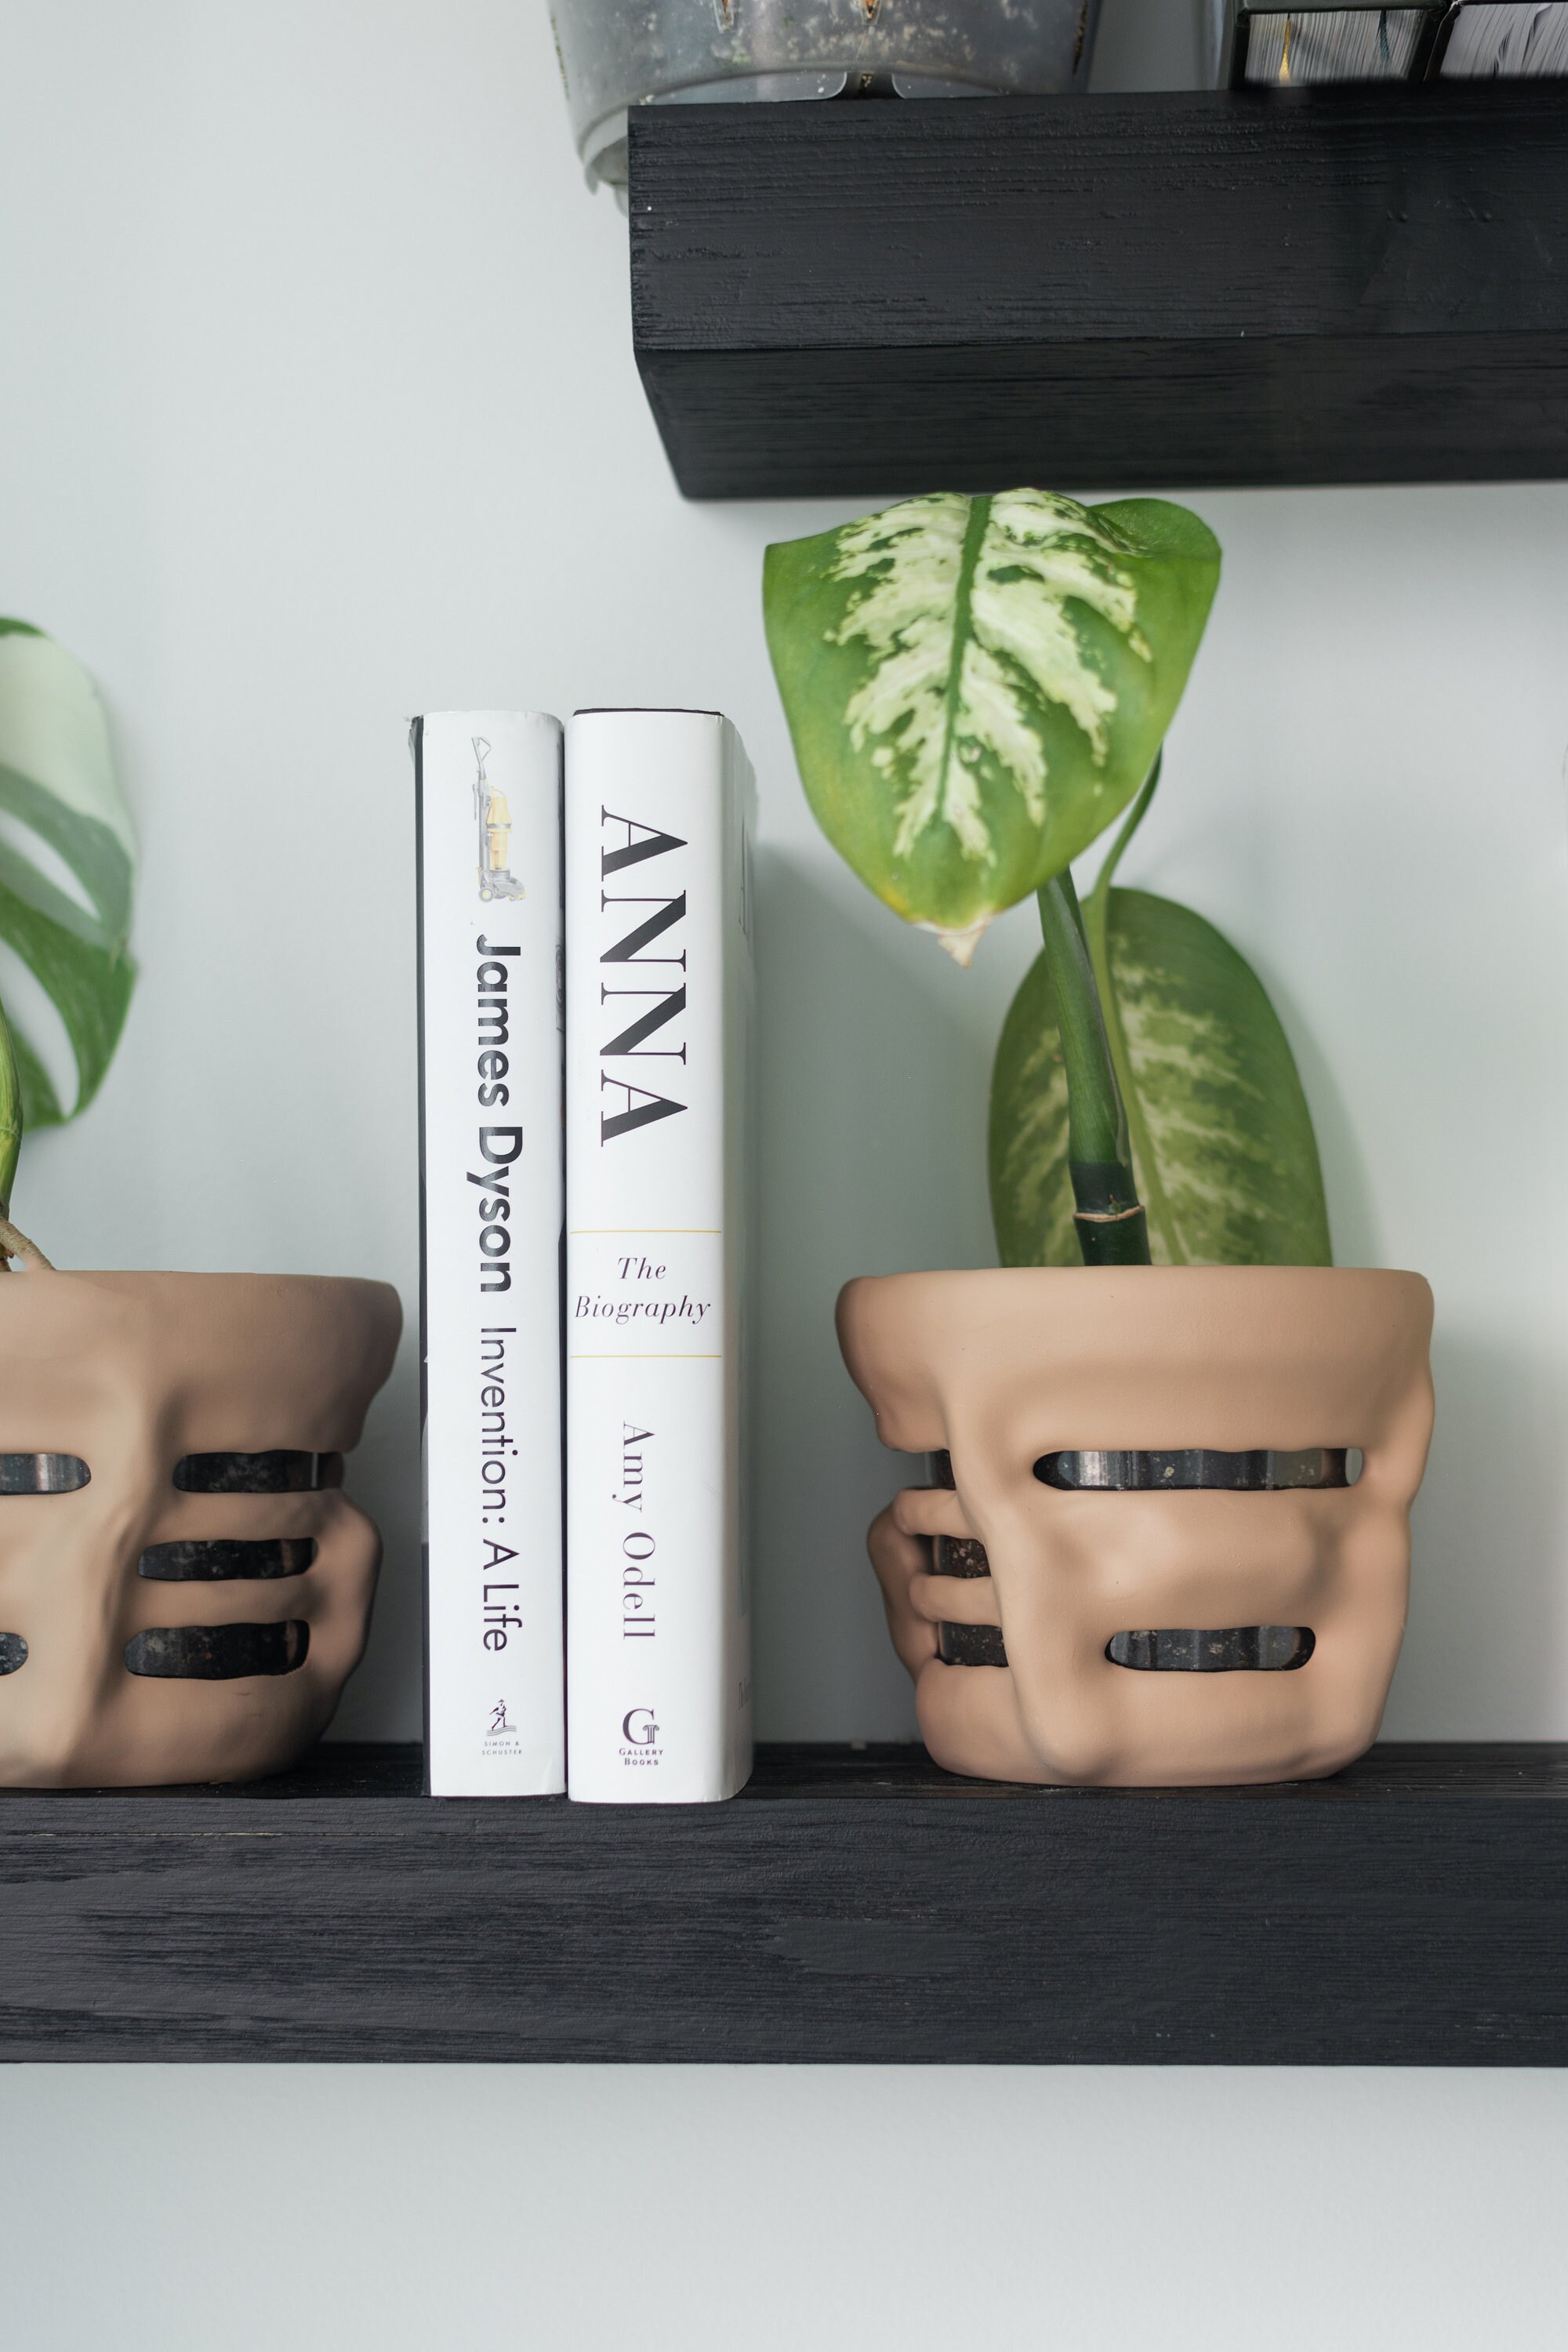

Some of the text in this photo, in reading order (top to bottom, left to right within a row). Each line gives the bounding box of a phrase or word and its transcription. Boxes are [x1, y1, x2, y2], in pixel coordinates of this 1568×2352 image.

[600, 804, 688, 1148] ANNA
[466, 934, 524, 1651] James Dyson Invention: A Life
[575, 1295, 711, 1325] Biography
[617, 1257, 666, 1279] The
[612, 1421, 656, 1640] Amy Odell
